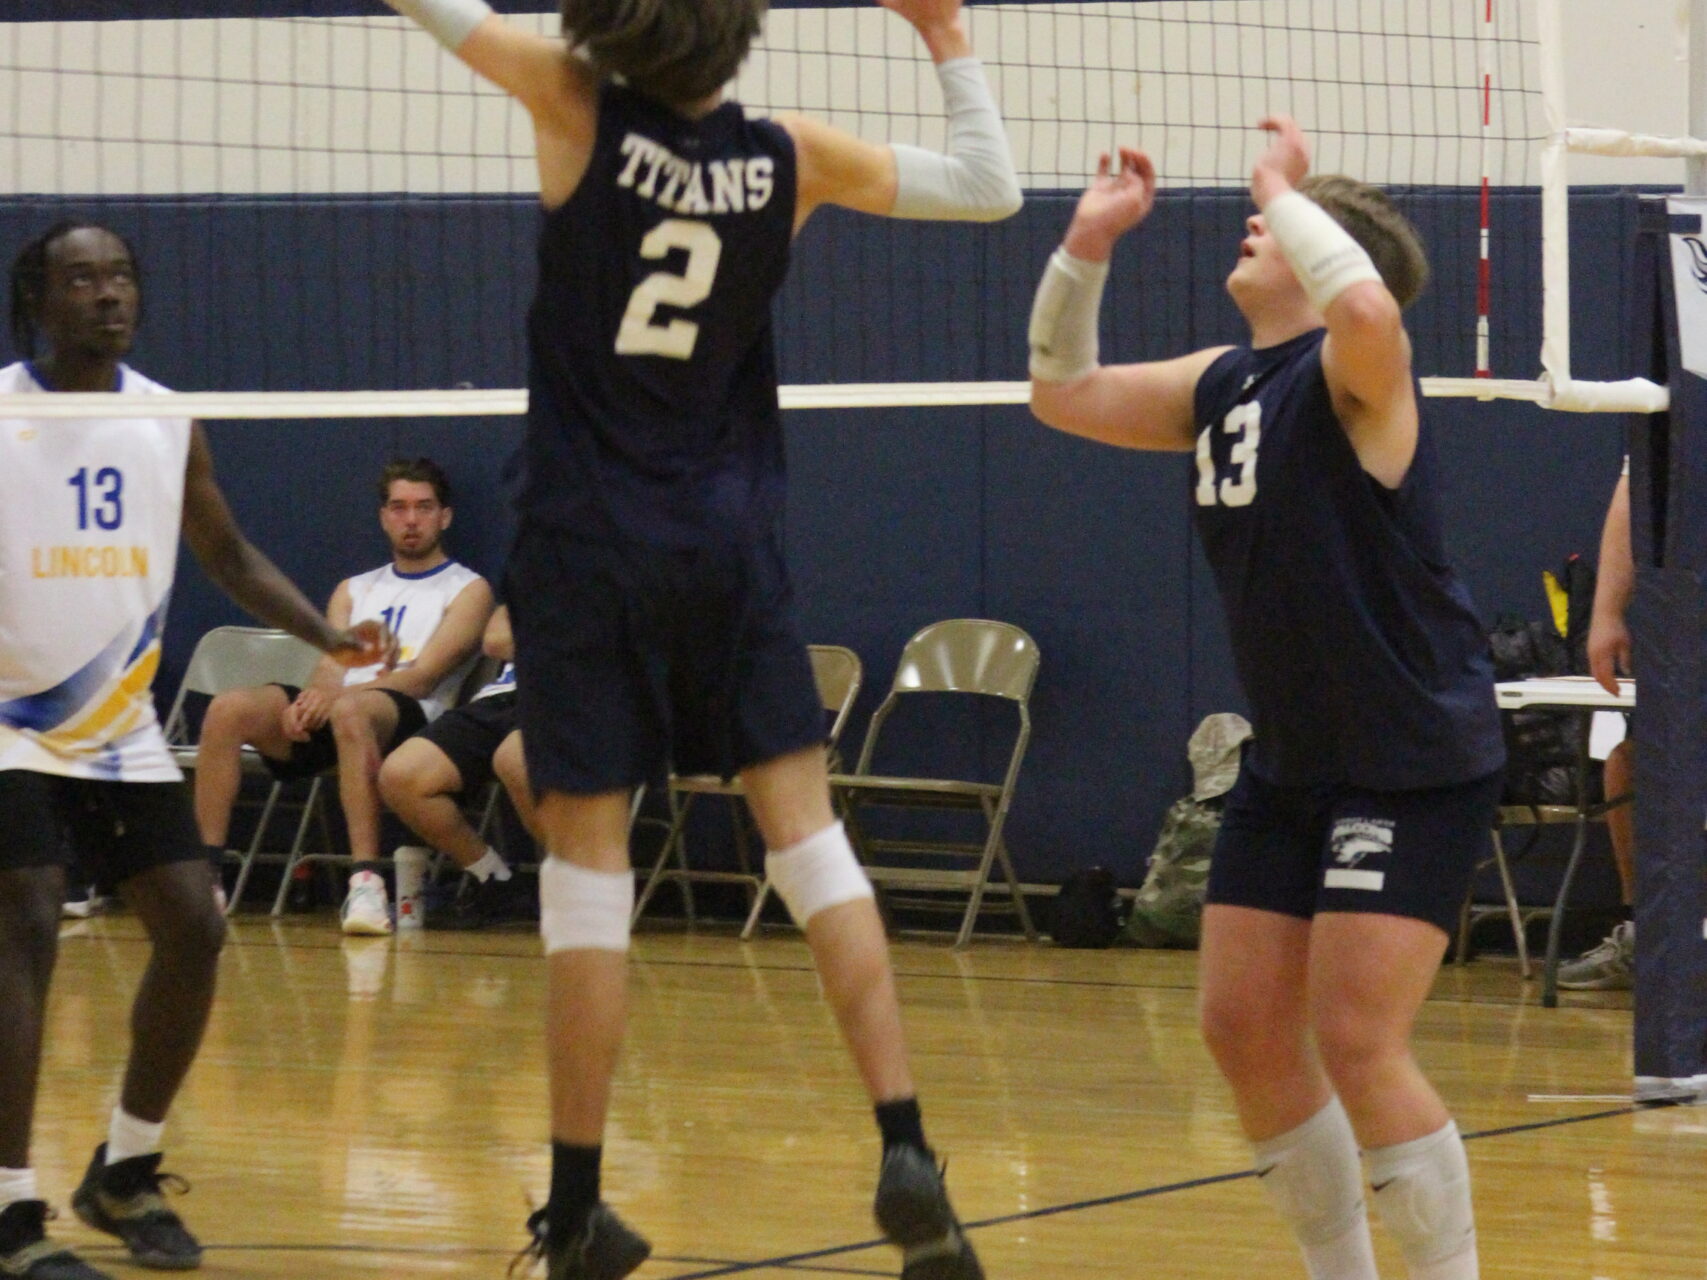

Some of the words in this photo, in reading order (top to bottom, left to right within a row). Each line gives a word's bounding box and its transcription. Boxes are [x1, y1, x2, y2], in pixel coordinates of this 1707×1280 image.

[616, 132, 775, 214] TITANS
[614, 218, 722, 361] 2
[1195, 400, 1263, 507] 13
[67, 466, 124, 531] 13
[31, 545, 149, 579] LINCOLN
